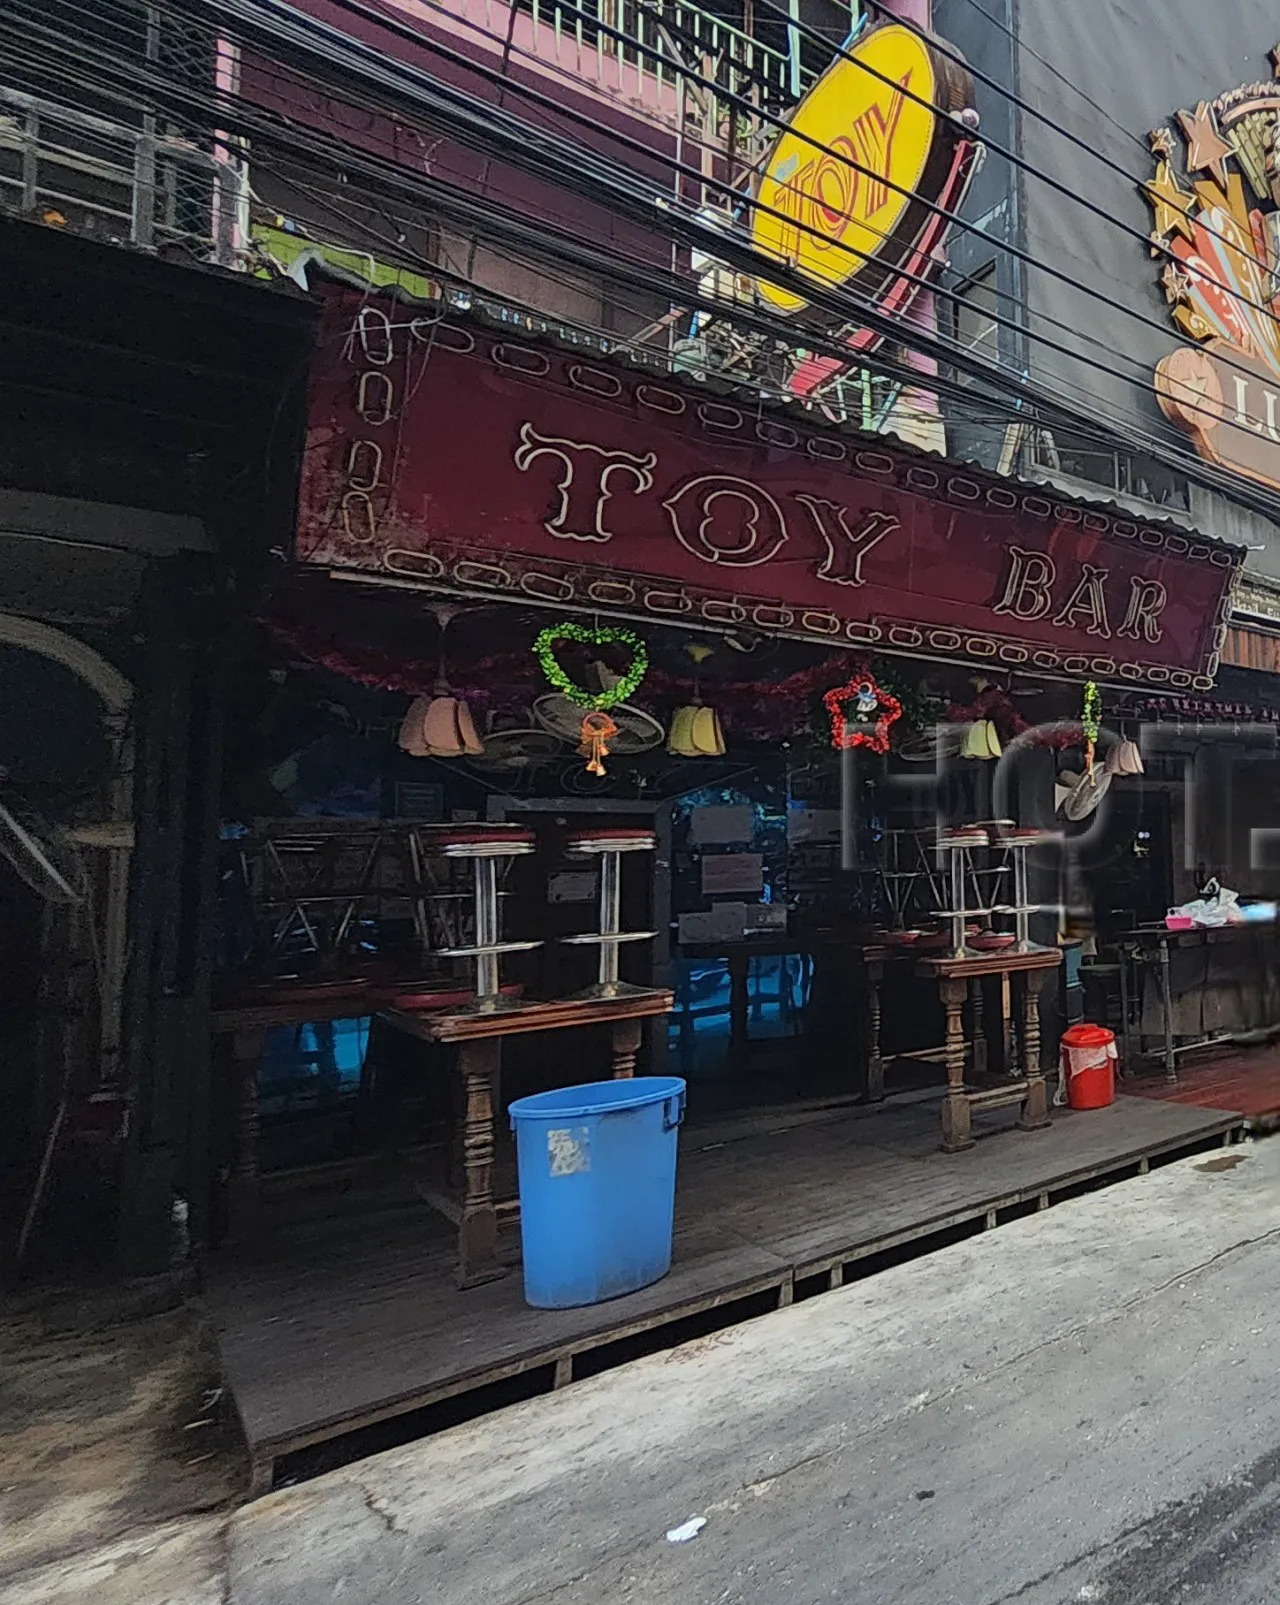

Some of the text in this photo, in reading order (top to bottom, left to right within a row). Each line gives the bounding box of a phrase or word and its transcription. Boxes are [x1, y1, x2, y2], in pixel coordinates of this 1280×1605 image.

[774, 67, 913, 266] TOY
[514, 422, 1167, 643] TOY BAR
